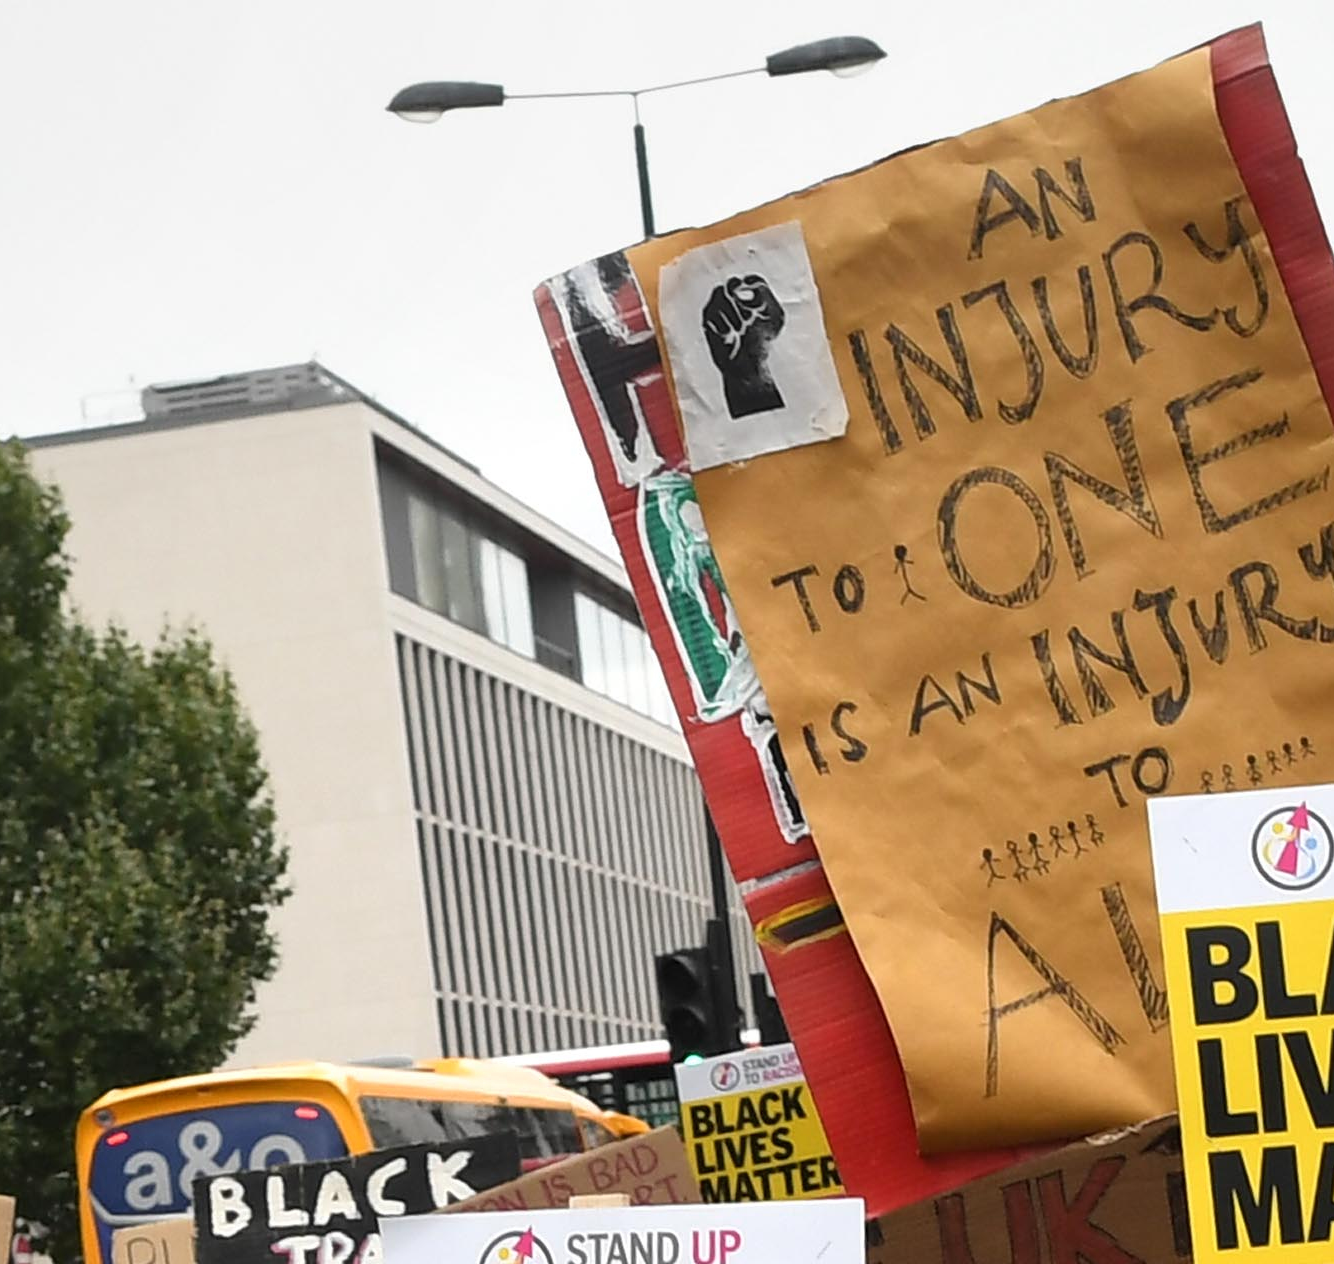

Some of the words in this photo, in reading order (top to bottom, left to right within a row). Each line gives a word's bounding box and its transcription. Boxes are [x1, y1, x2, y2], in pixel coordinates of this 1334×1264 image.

[965, 157, 1099, 261] AN
[845, 193, 1273, 458] INJURY
[771, 563, 866, 635] TO
[935, 368, 1333, 610] ONE
[802, 702, 868, 775] IS
[908, 652, 1004, 736] AN
[1085, 744, 1175, 810] TO
[742, 1055, 779, 1071] STAND
[745, 1073, 760, 1085] TO
[689, 1086, 807, 1138] BLACK
[539, 1175, 575, 1207] IS
[587, 1144, 658, 1192] BAD
[694, 1127, 794, 1175] LIVES
[700, 1155, 842, 1204] MATTER
[209, 1151, 477, 1238] BLACK
